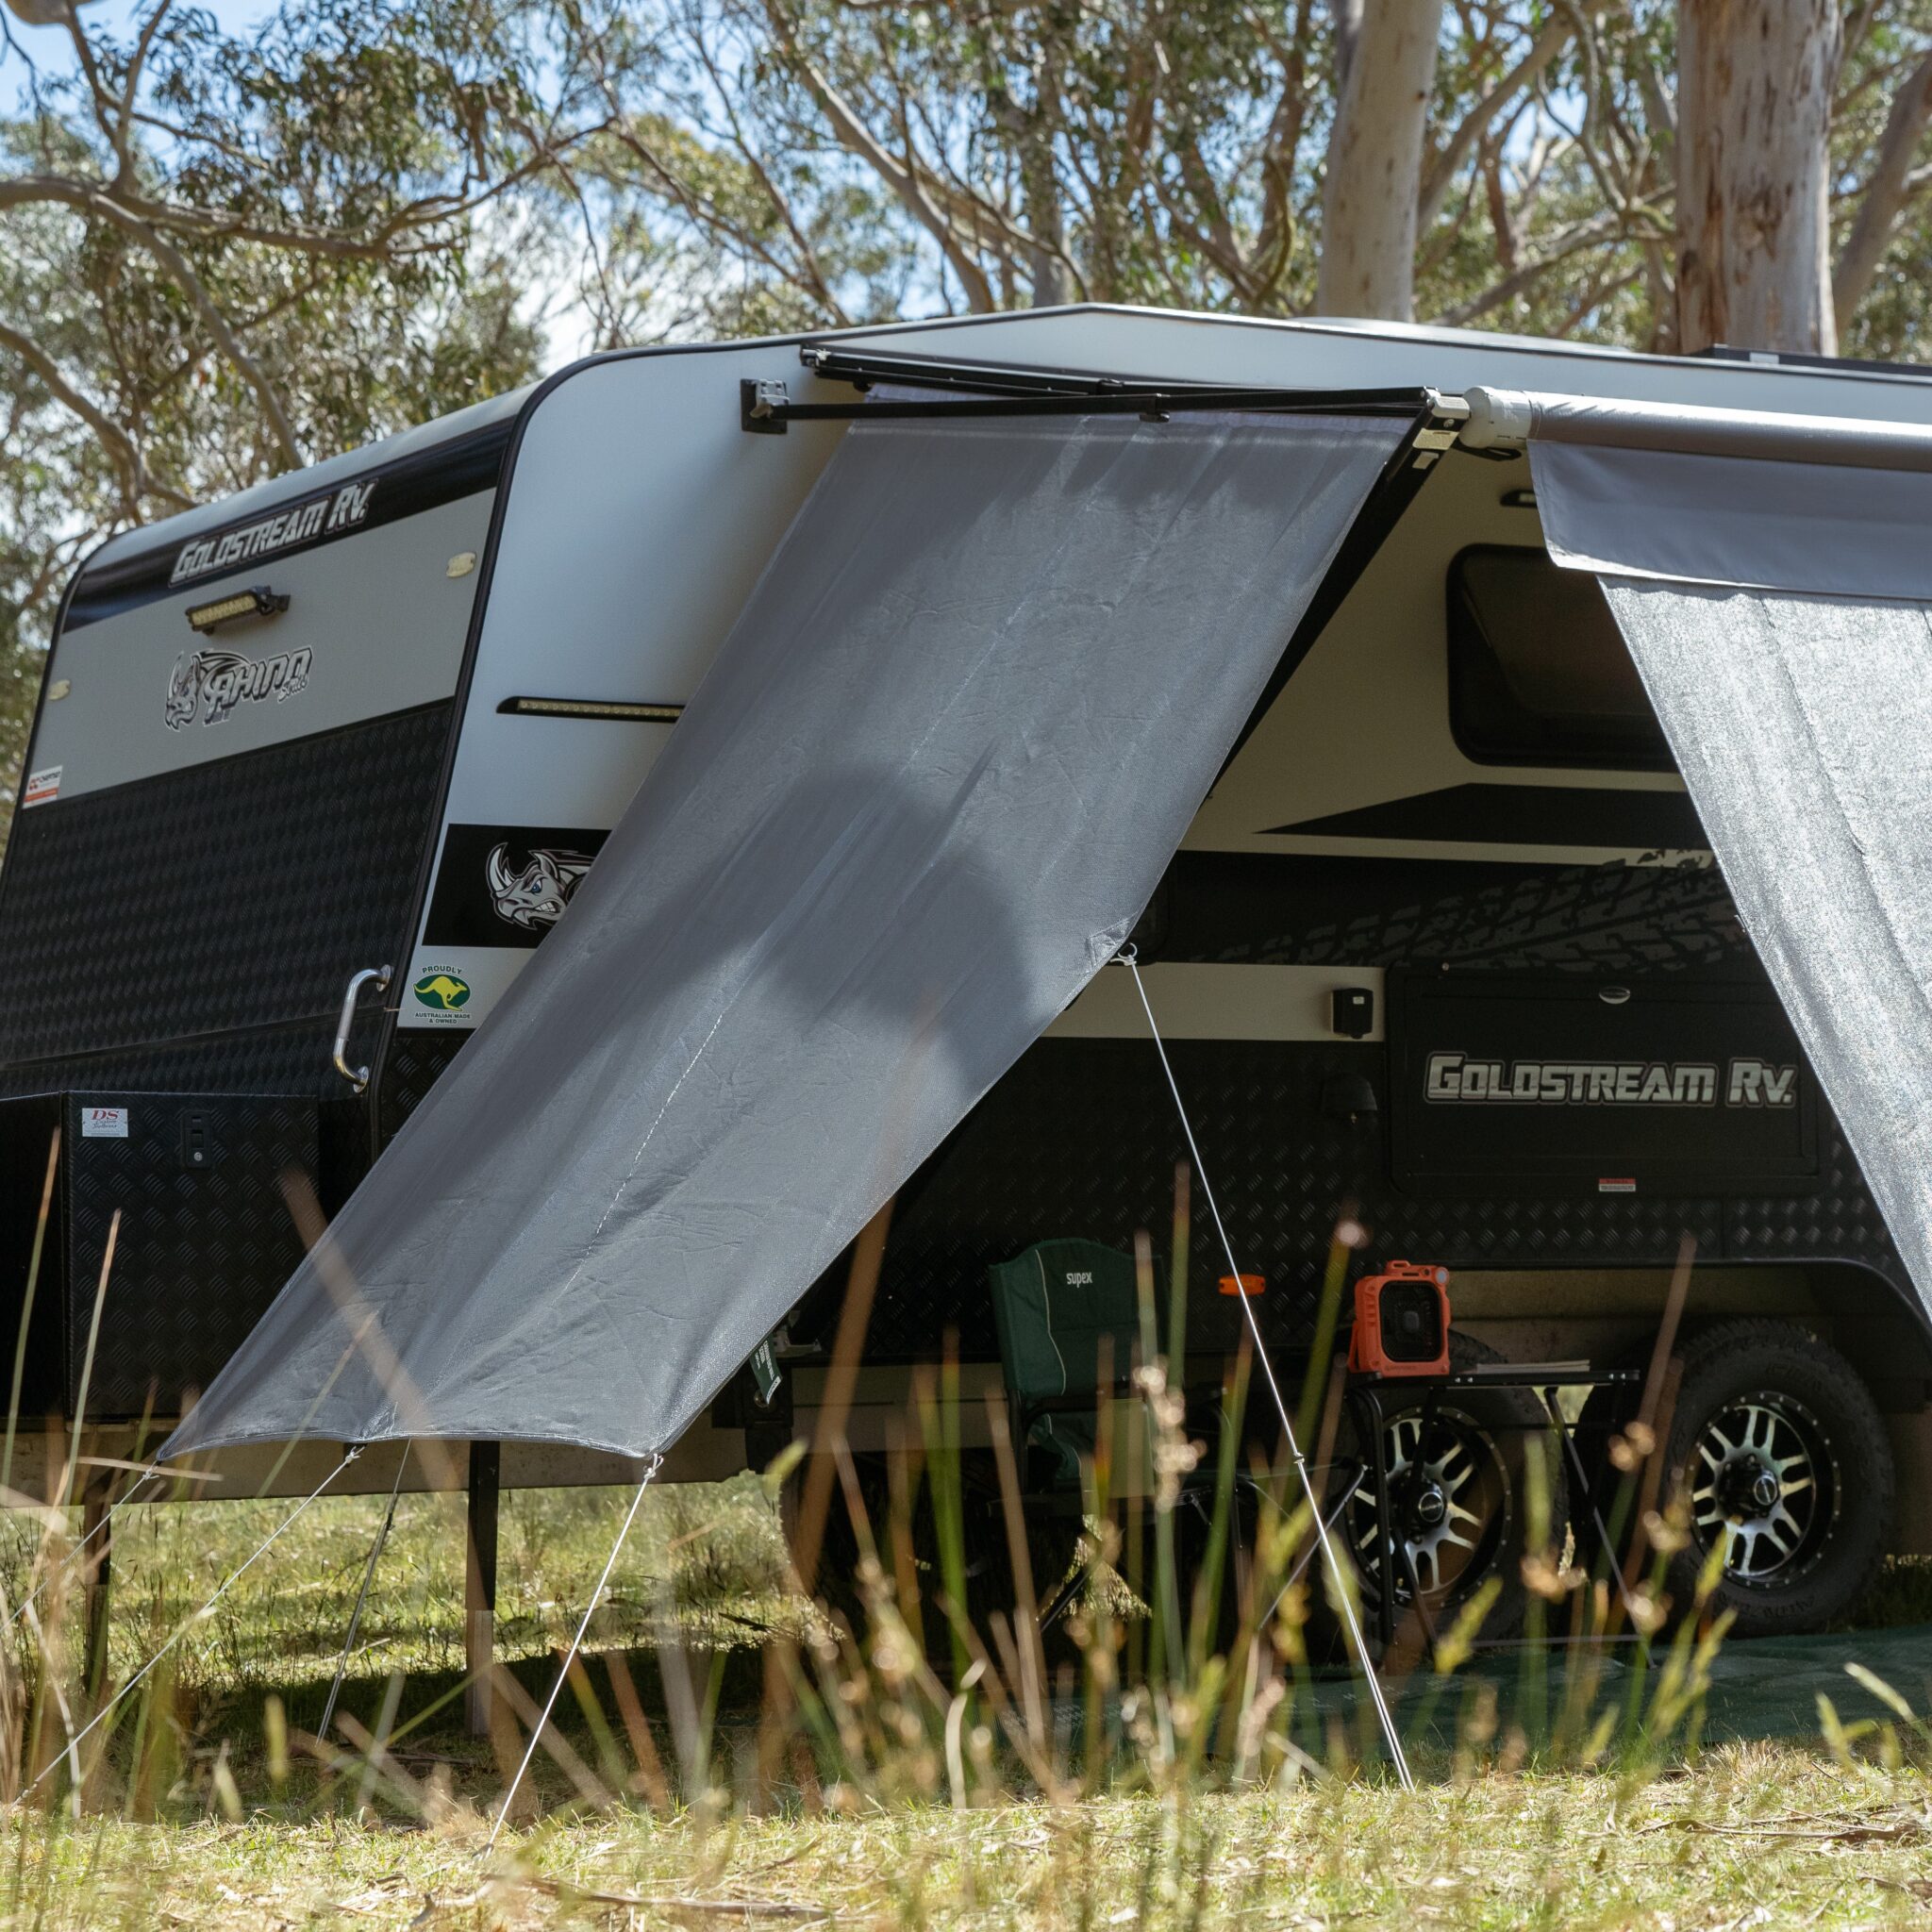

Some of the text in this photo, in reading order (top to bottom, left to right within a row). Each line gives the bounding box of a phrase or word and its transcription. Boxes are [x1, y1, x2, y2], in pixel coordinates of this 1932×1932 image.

[170, 499, 330, 585] GOLDSTREAM
[422, 965, 462, 974] PROUDLY
[1426, 1054, 1717, 1104] GOLDSTREAM
[91, 1109, 119, 1120] DS
